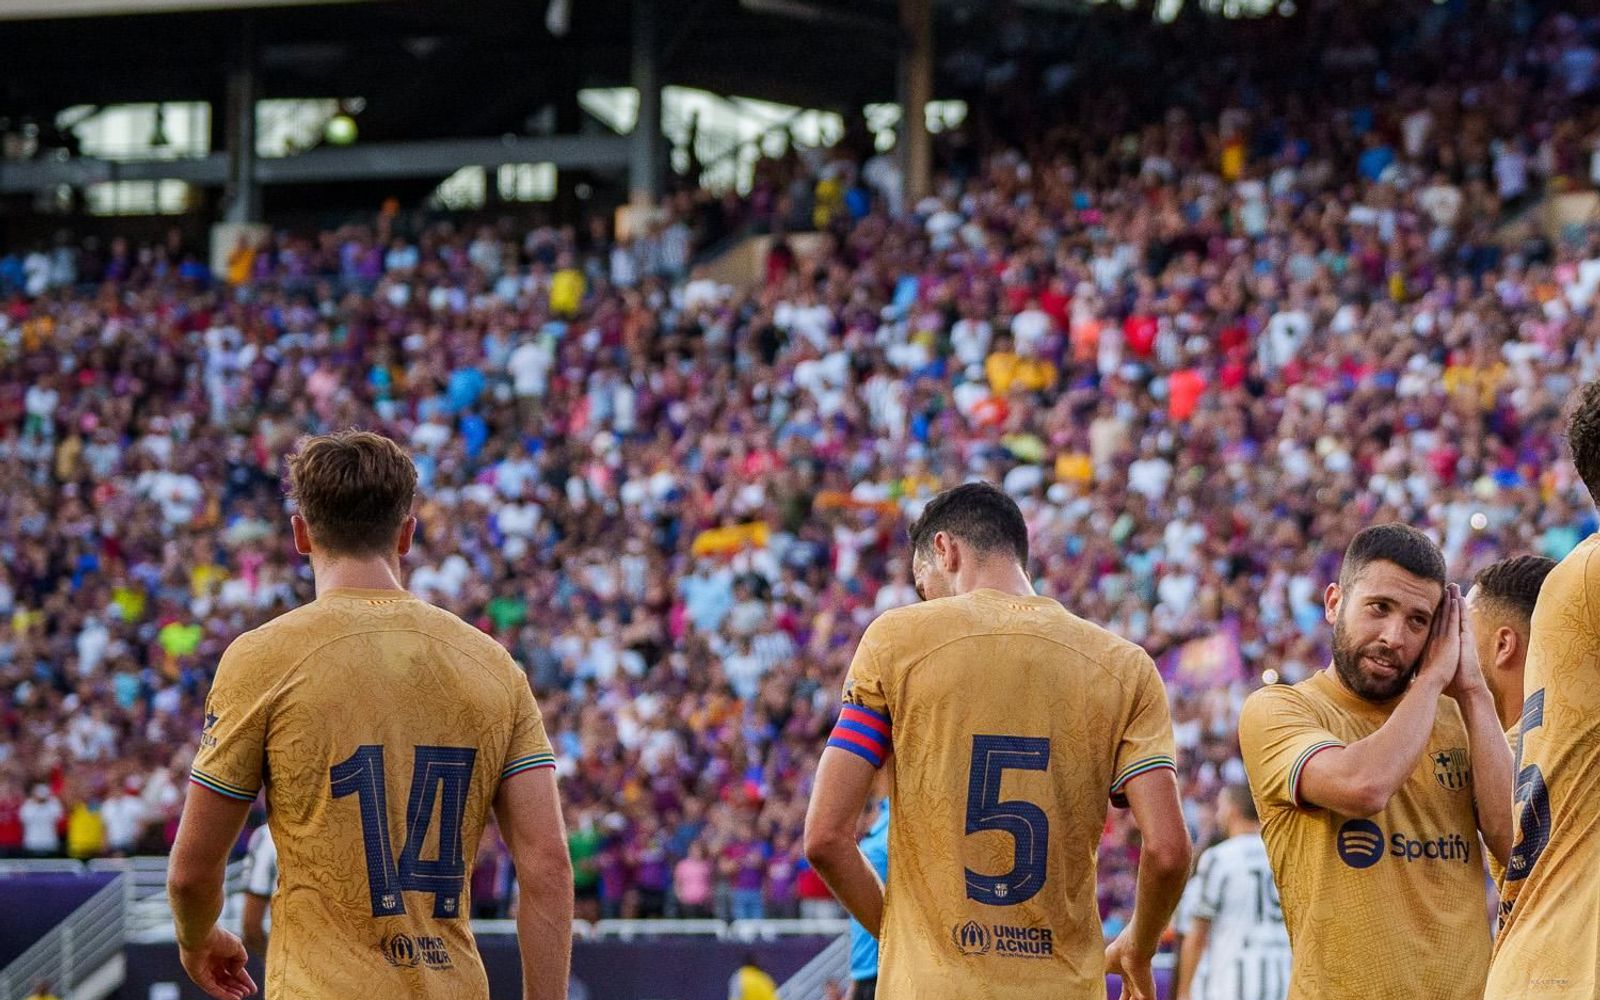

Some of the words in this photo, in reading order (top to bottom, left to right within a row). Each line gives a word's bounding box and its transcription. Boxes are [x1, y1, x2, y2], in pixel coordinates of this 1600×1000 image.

[330, 745, 478, 918] 14
[964, 734, 1050, 906] 5
[1391, 833, 1469, 863] Spotify
[994, 925, 1052, 942] UNHCR
[995, 939, 1052, 955] ACNUR
